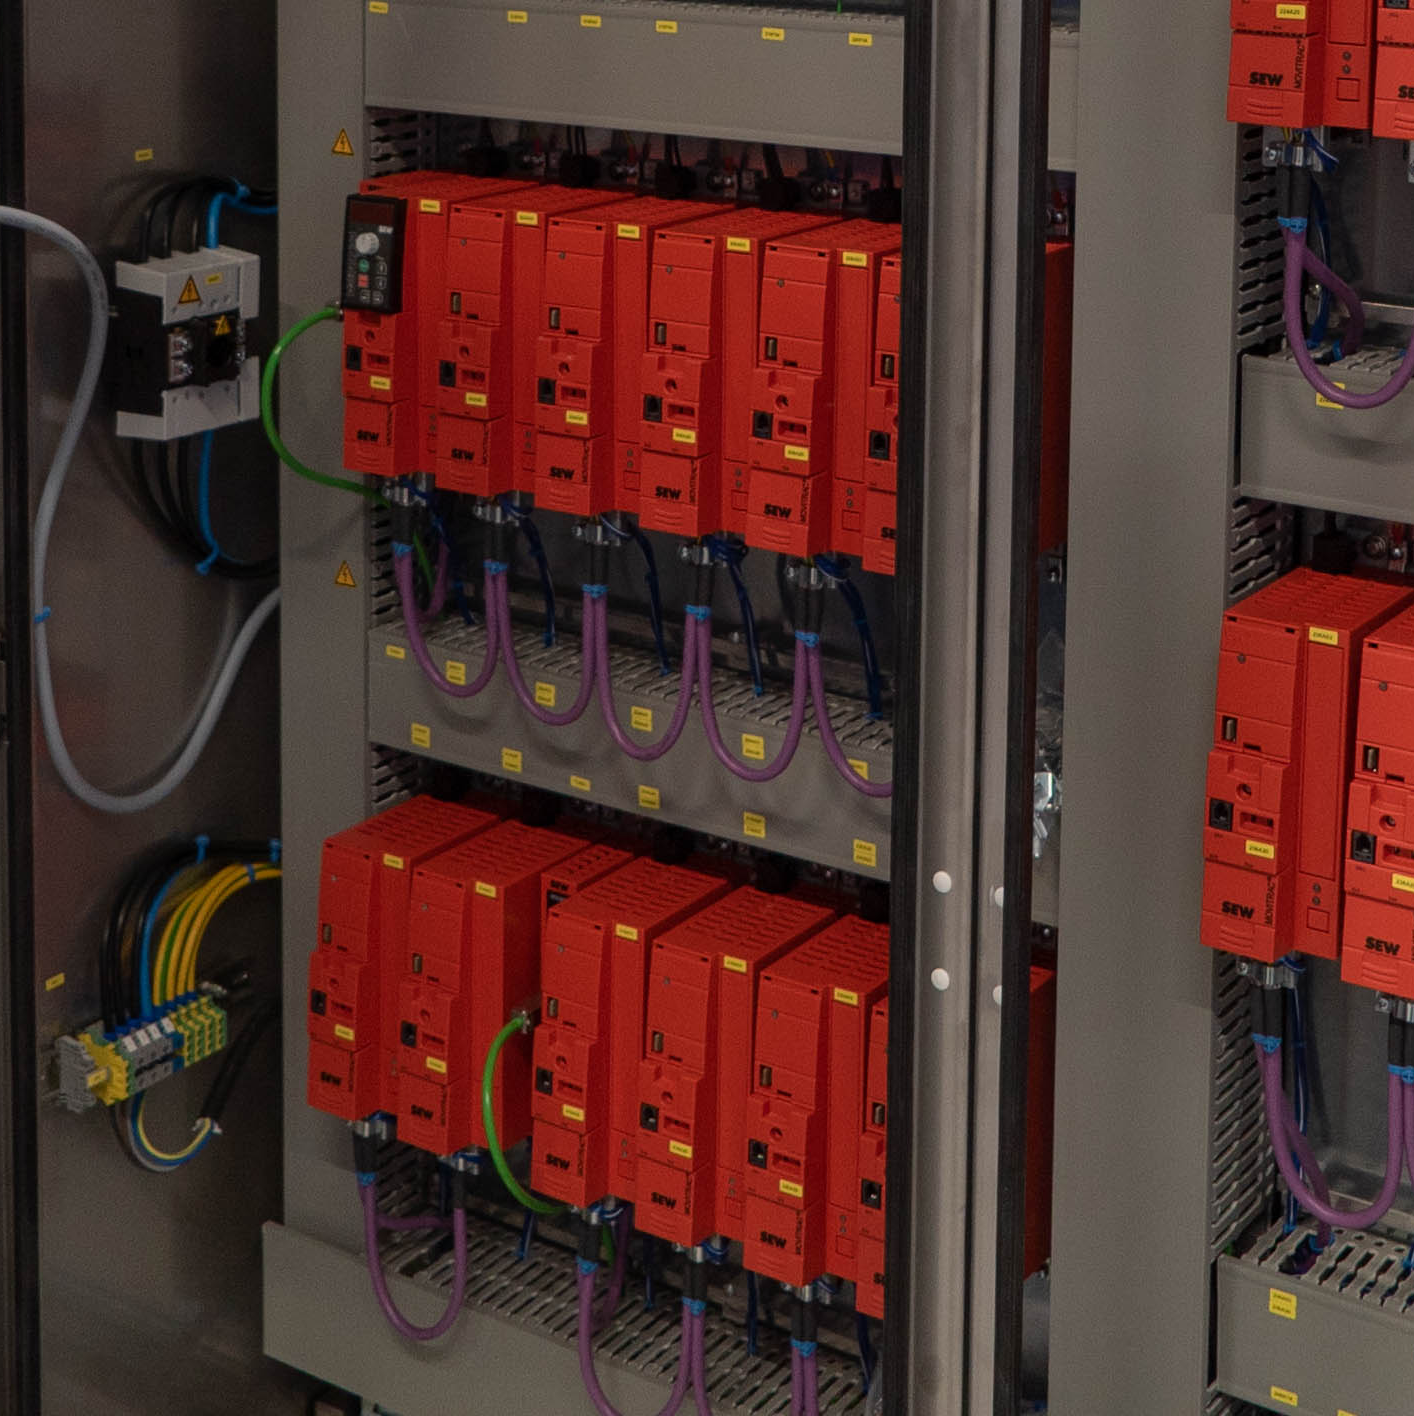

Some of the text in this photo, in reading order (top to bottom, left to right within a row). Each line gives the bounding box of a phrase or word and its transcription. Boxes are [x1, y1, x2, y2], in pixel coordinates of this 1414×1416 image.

[1249, 72, 1283, 86] SEW
[357, 430, 379, 442] SEW
[451, 448, 474, 461] SEW
[550, 467, 574, 480] SEW
[656, 486, 681, 499] SEW
[764, 504, 791, 520] SEW
[881, 526, 895, 538] SE
[547, 880, 568, 894] SEW
[1222, 901, 1254, 919] SEW
[1365, 936, 1400, 955] SEW
[321, 1072, 341, 1086] SEW
[411, 1105, 433, 1120] SEW
[546, 1154, 570, 1170] SEW
[651, 1192, 676, 1208] SEW
[760, 1231, 787, 1248] SEW
